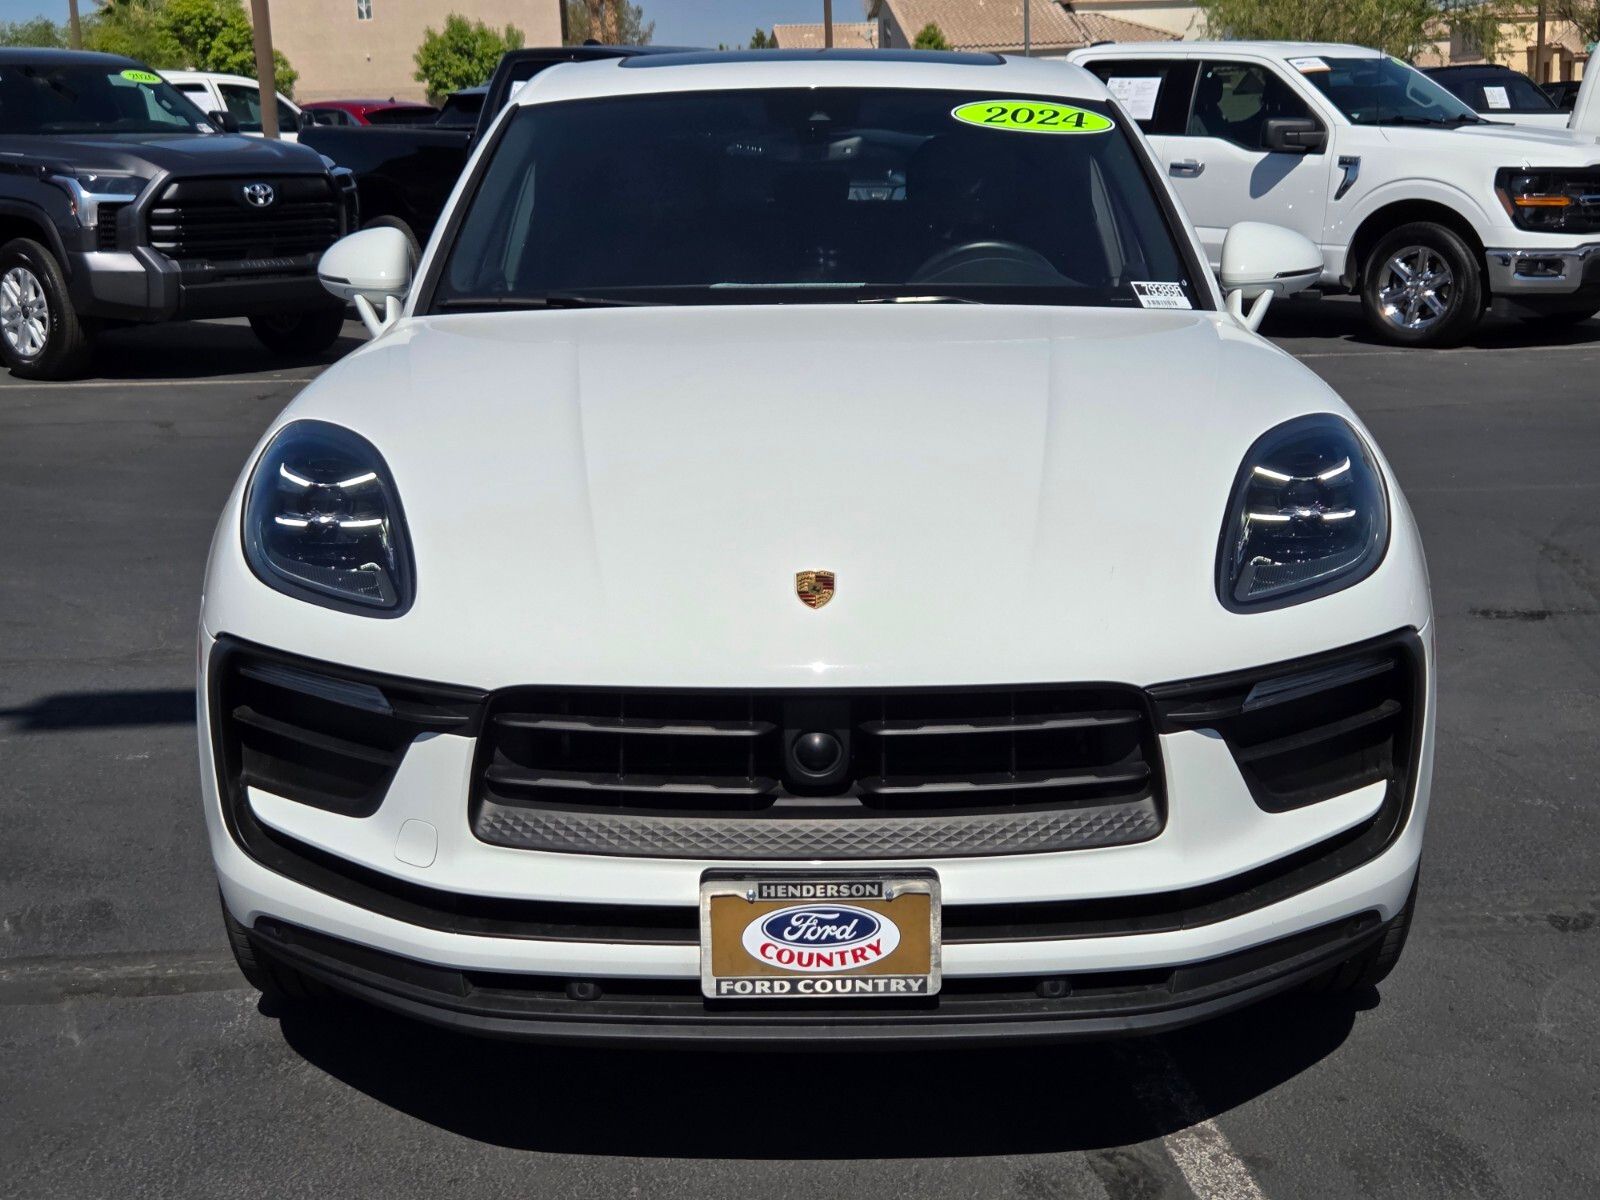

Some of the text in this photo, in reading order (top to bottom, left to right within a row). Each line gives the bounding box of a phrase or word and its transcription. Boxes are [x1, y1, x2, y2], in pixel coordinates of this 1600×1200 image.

[984, 106, 1088, 128] 2024
[762, 883, 879, 898] HENDERSON
[783, 912, 860, 941] Ford
[759, 938, 883, 968] COUNTRY
[720, 978, 924, 994] FORD COUNTRY
